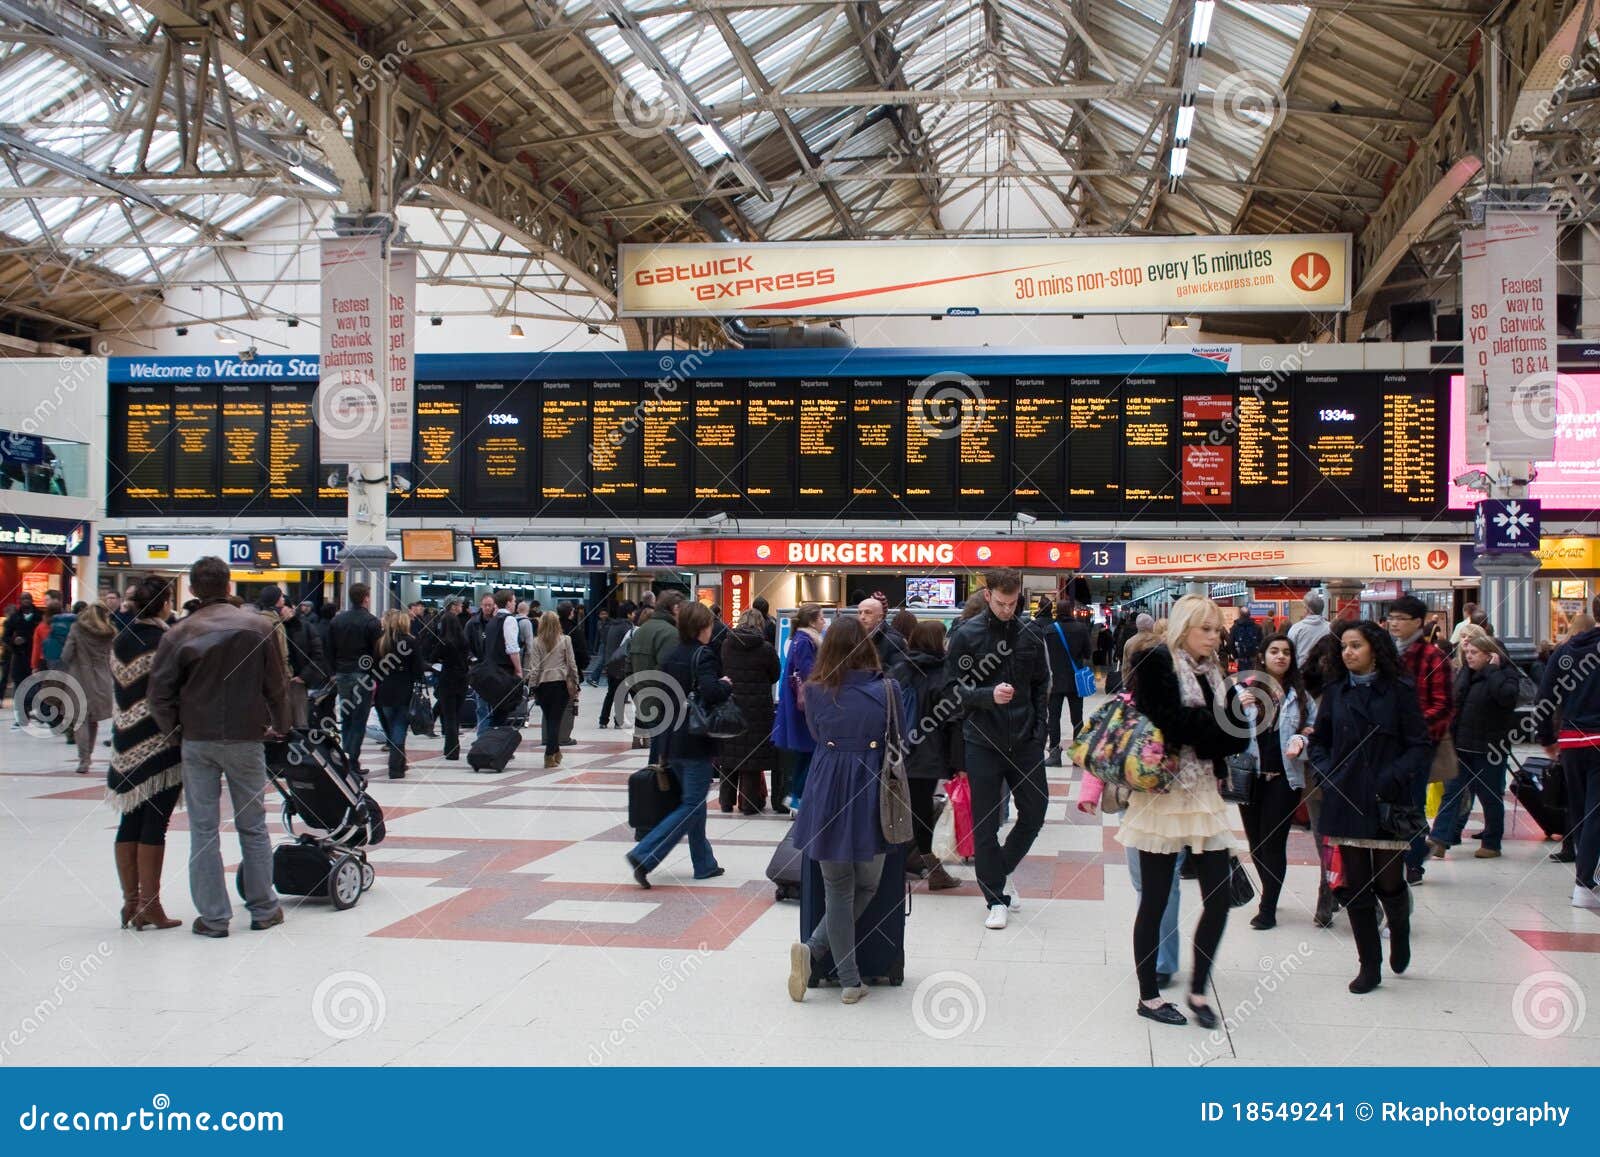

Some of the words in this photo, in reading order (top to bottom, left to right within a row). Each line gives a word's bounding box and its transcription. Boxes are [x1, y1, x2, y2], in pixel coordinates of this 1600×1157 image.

[1014, 278, 1034, 299] 30
[1038, 275, 1073, 296] mins
[1077, 267, 1142, 287] non-stop
[1148, 260, 1188, 281] every
[1192, 254, 1207, 275] 15
[1212, 249, 1272, 273] minutes
[1176, 273, 1274, 297] gatwickexpress.com
[1502, 278, 1542, 294] Fastest
[333, 298, 369, 313] Fastest
[1506, 299, 1528, 314] way
[1532, 297, 1543, 311] to
[337, 316, 357, 332] way
[360, 314, 370, 328] to
[1500, 317, 1545, 333] Gatwick
[331, 332, 372, 348] Gatwick
[1493, 336, 1547, 356] platforms
[324, 351, 373, 368] platforms
[1512, 358, 1523, 374] 13
[1526, 357, 1536, 373] &
[1539, 356, 1548, 372] 14
[130, 363, 193, 378] Welcome
[196, 364, 211, 378] to
[214, 359, 284, 377] Victoria
[287, 359, 320, 376] Sta
[341, 370, 351, 385] 13
[365, 368, 375, 383] 14
[748, 380, 776, 388] Departures
[232, 544, 250, 559] 10
[325, 546, 339, 560] 11
[584, 545, 600, 560] 12
[788, 542, 884, 563] BURGER
[892, 544, 954, 563] KING
[1092, 551, 1109, 566] 13
[1373, 552, 1420, 572] Tickets
